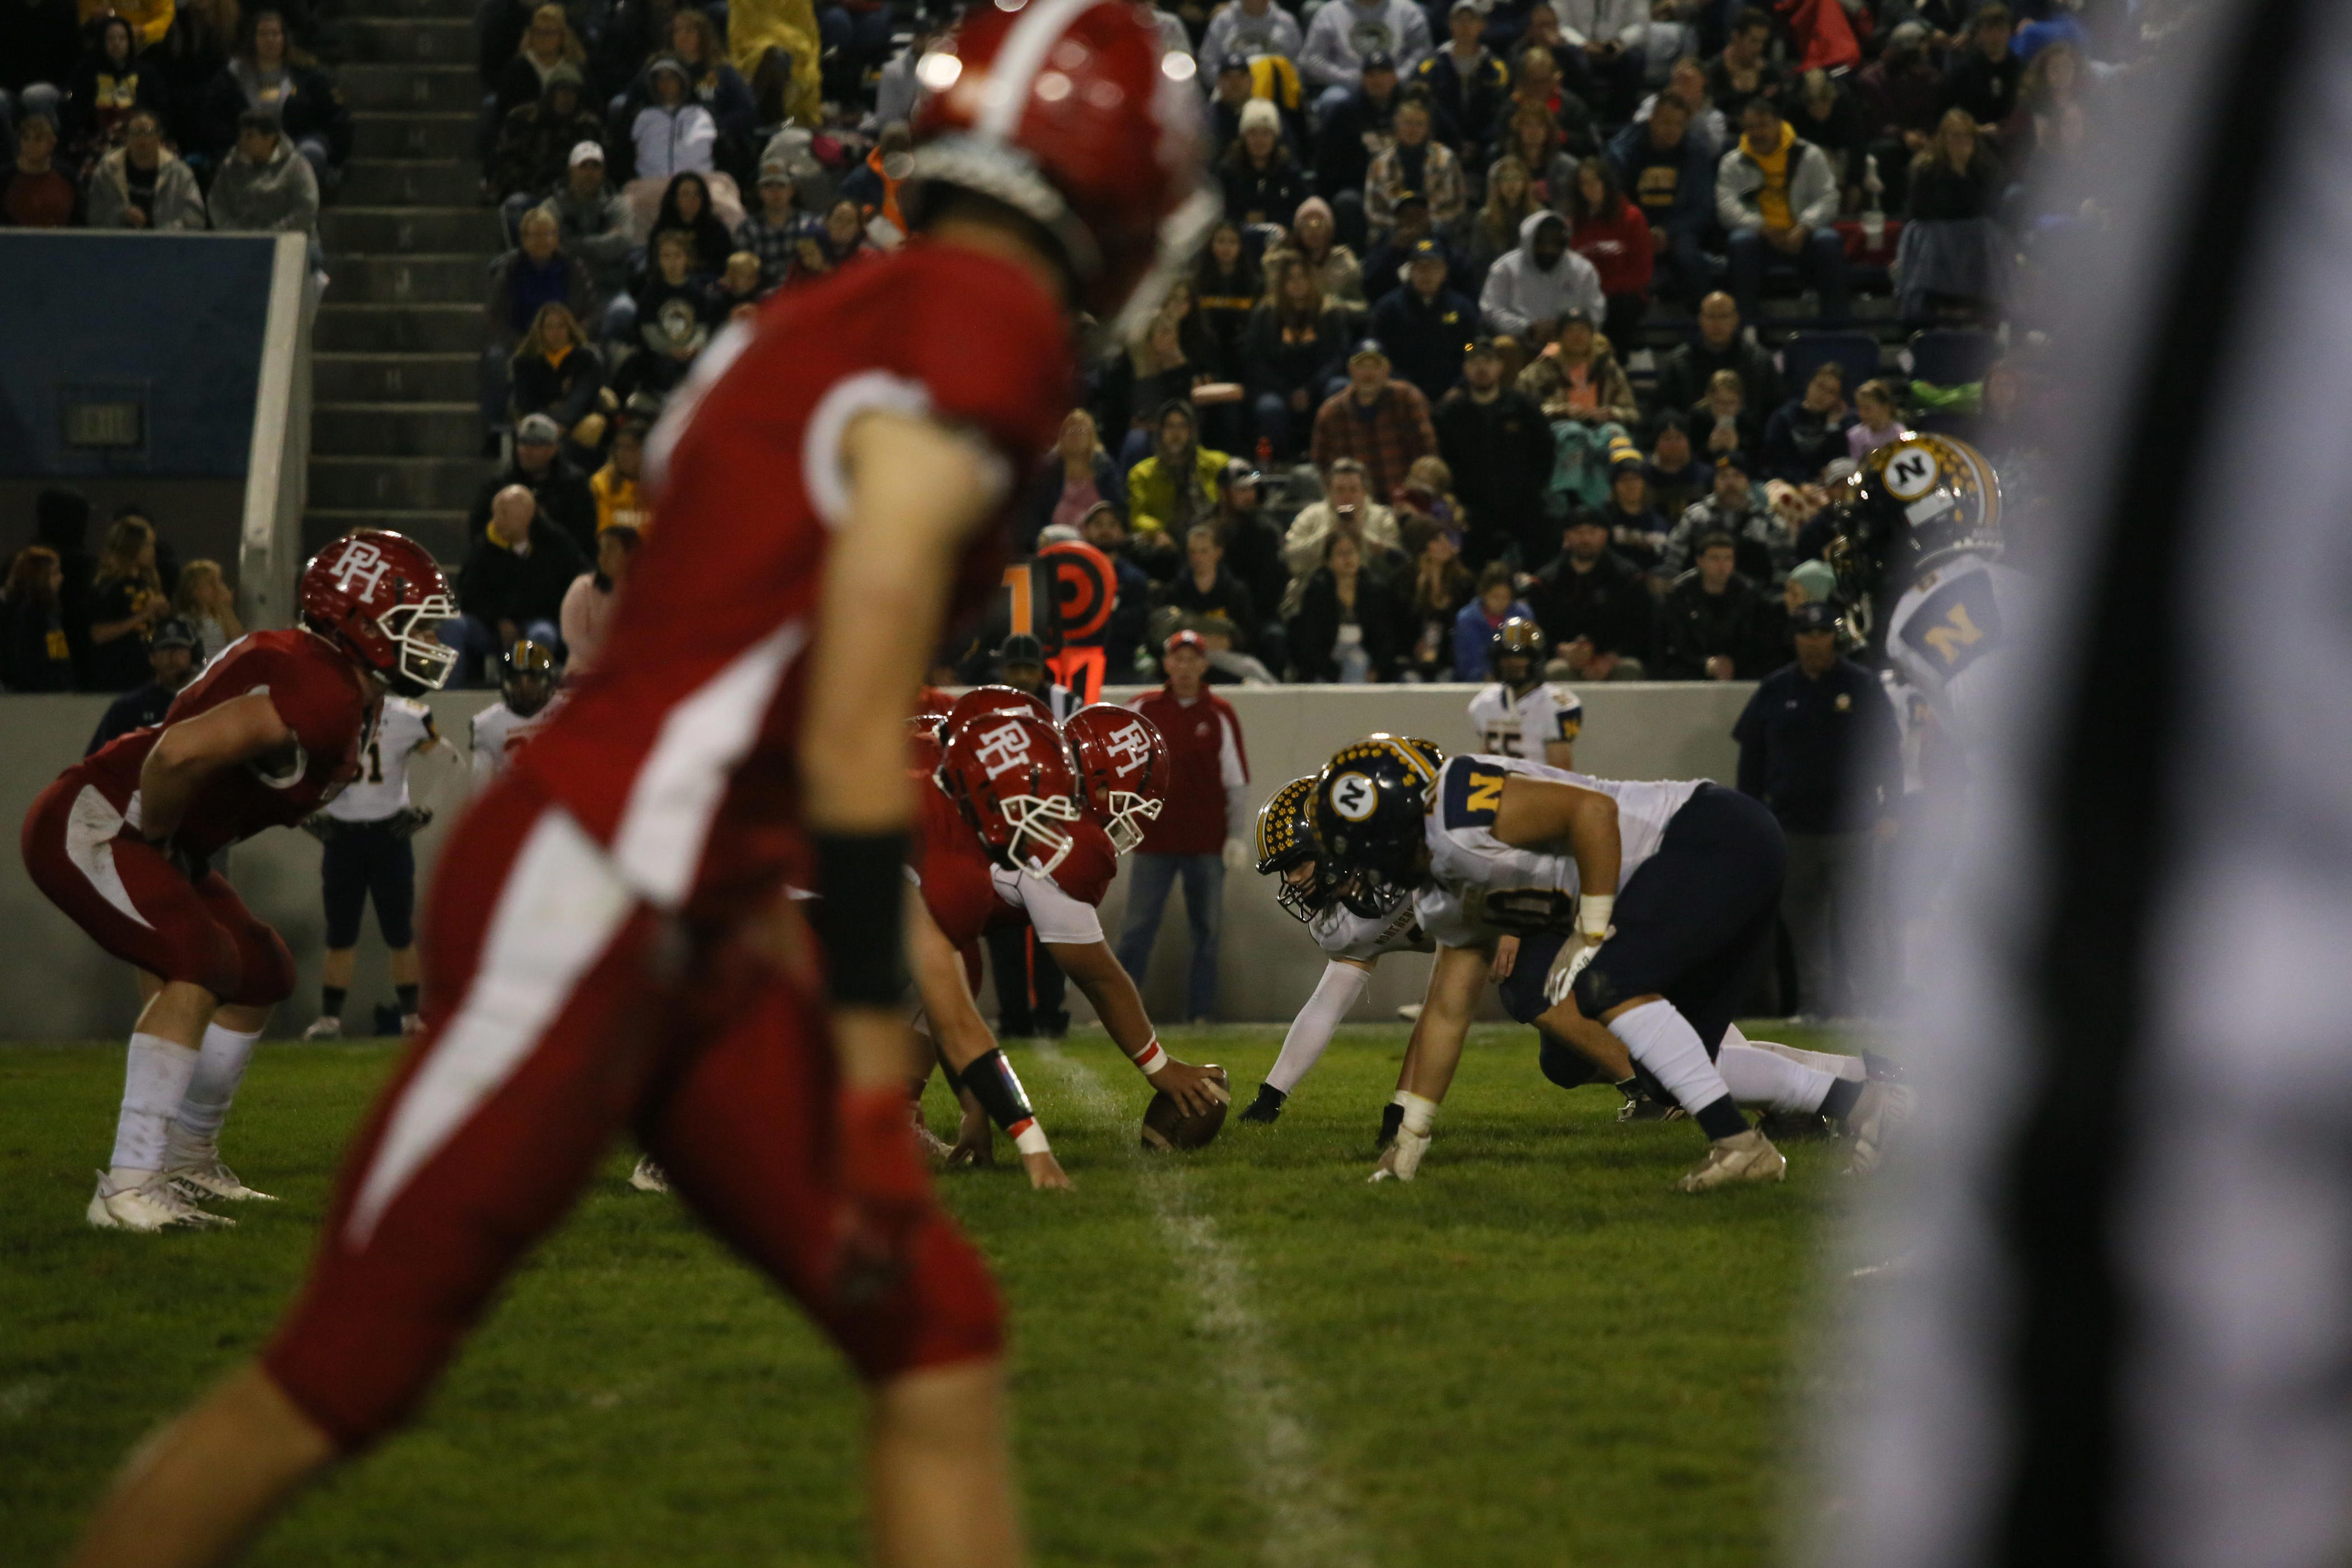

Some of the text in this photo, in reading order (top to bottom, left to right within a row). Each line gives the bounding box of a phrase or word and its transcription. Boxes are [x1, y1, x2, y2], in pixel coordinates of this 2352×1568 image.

[1896, 456, 1925, 484] N
[1000, 564, 1033, 636] 1
[1924, 603, 1984, 664] N
[1339, 781, 1365, 811] N
[1466, 771, 1504, 812] N
